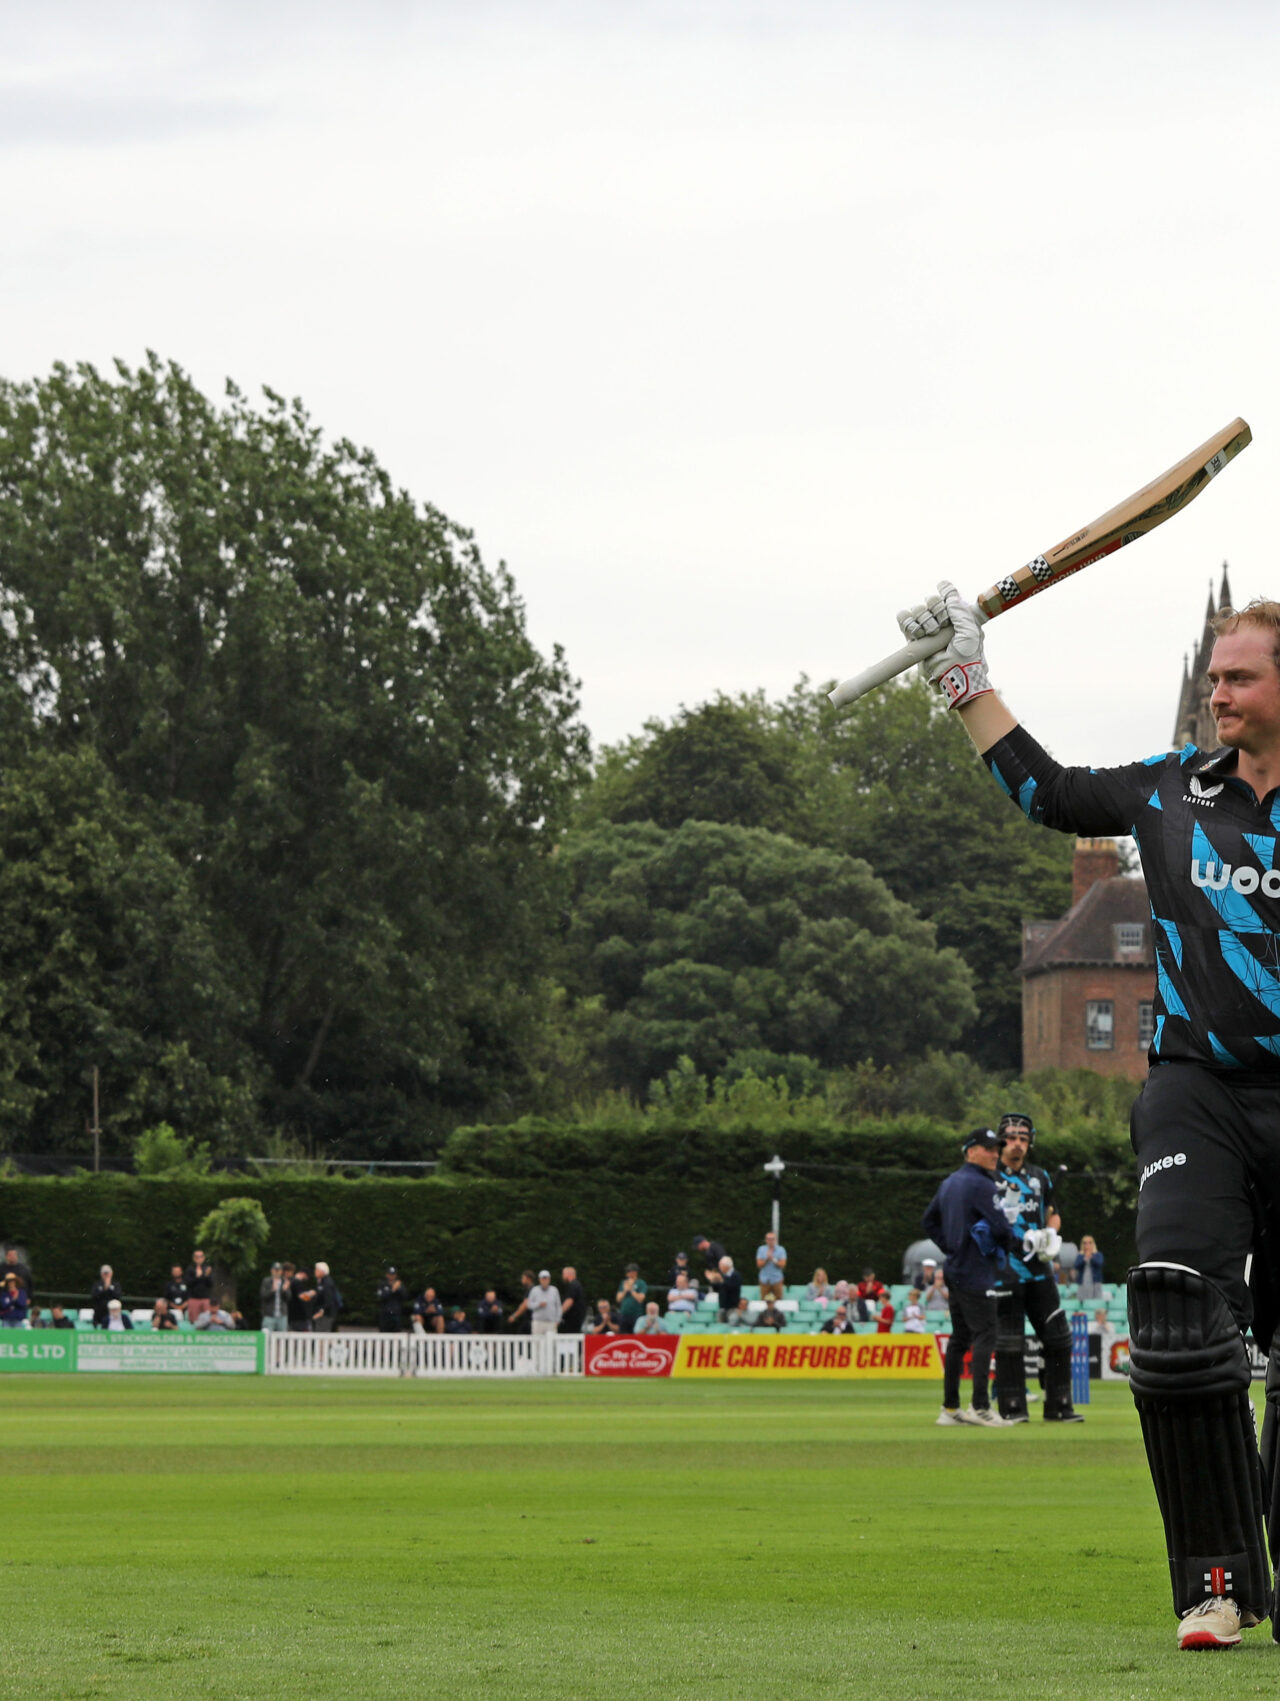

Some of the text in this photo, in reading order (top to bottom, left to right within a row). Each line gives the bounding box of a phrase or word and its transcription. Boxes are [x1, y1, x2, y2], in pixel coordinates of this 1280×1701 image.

[1182, 794, 1215, 808] CASTORE
[1139, 1152, 1188, 1192] pluxee
[33, 1343, 66, 1359] LTD
[686, 1345, 933, 1368] THE CAR REFURB CENTRE
